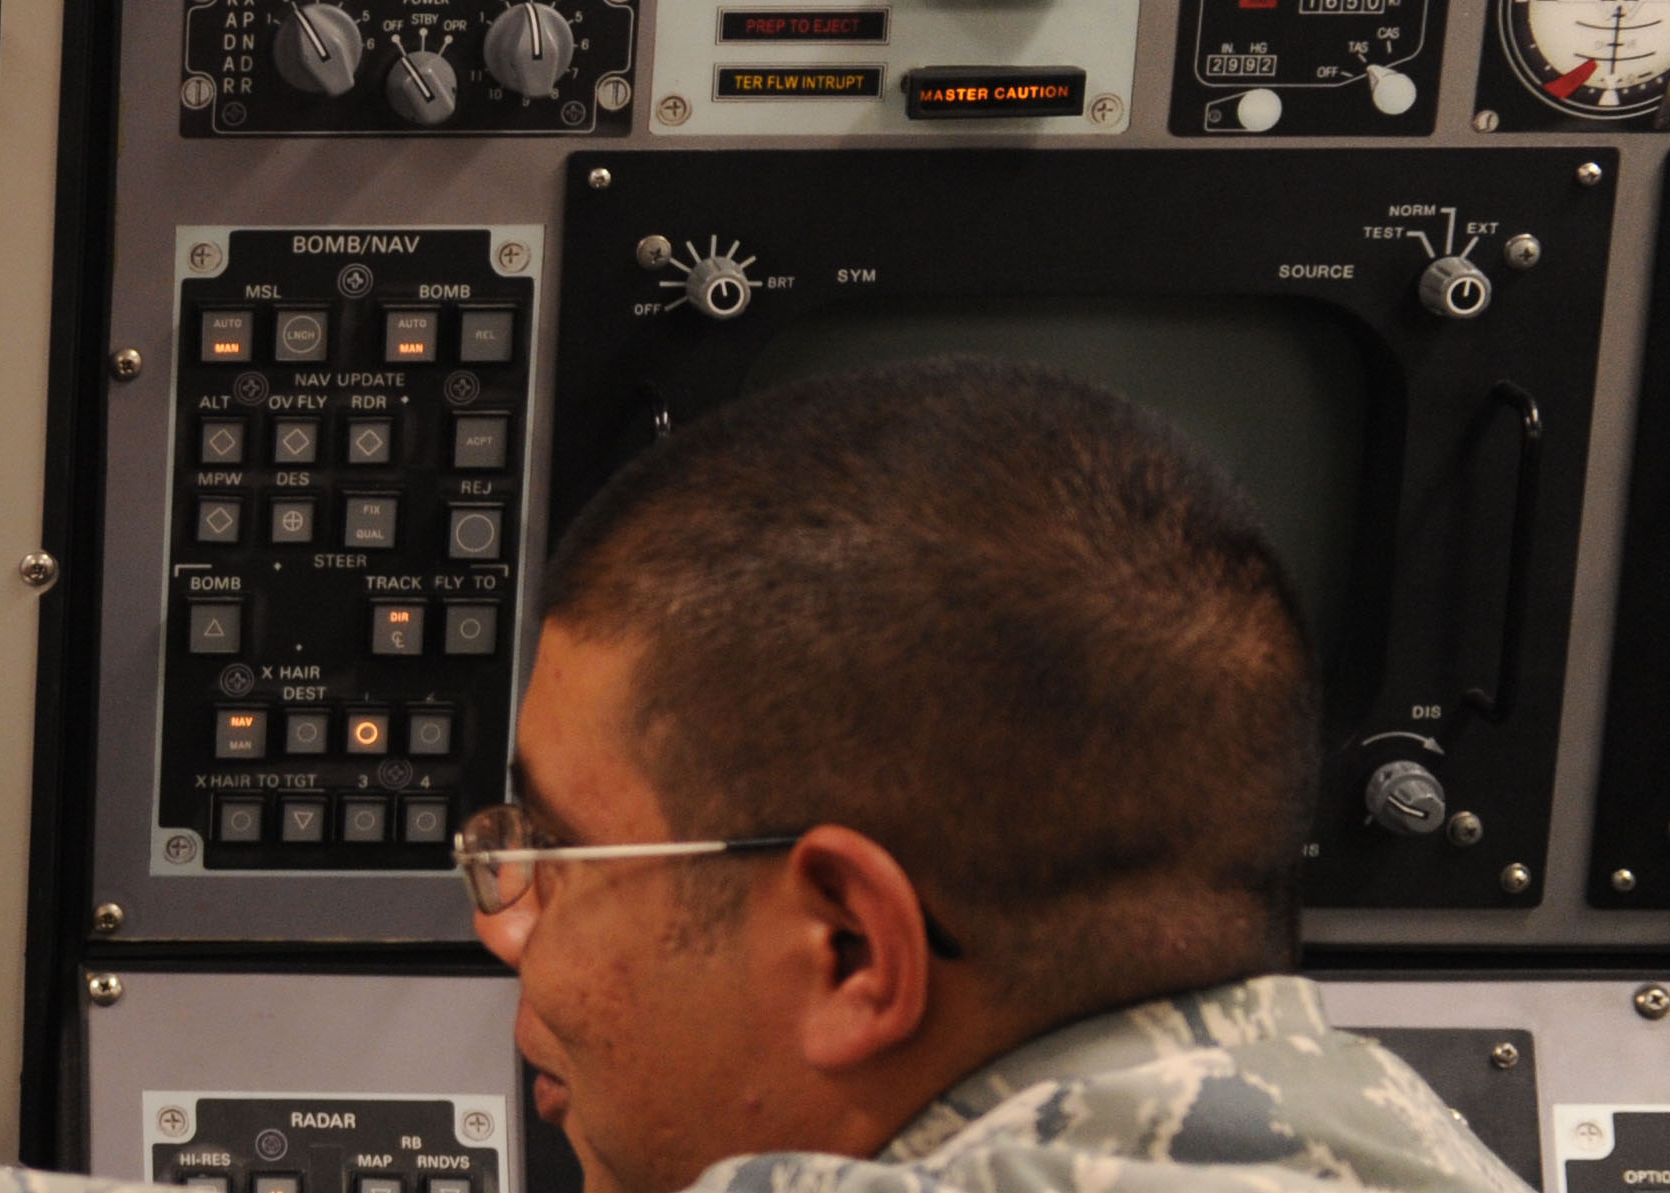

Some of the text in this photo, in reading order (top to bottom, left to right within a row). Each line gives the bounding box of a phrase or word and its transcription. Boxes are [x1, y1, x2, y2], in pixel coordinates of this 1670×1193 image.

[383, 20, 403, 32] OFF
[412, 14, 438, 25] STBY
[444, 20, 466, 32] OPR
[746, 18, 859, 34] PREP TO EJECT
[1378, 27, 1399, 40] CAS
[1250, 42, 1268, 54] HG
[1348, 41, 1368, 54] TAS
[1212, 58, 1272, 73] 2992
[1317, 67, 1338, 78] OFF
[735, 74, 864, 90] TER FLW INTRUPT
[919, 86, 1069, 102] MASTER CAUTION
[1389, 205, 1436, 217] NORM
[1364, 226, 1403, 239] TEST
[1467, 222, 1498, 234] EXT
[293, 236, 419, 254] BOMB/NAV
[837, 269, 876, 283] SYM
[1279, 265, 1354, 279] SOURCE
[768, 277, 794, 289] BRT
[246, 285, 281, 298] MSL
[419, 285, 470, 298] BOMB
[634, 304, 660, 316] OFF
[213, 319, 241, 328] AUTO
[398, 319, 426, 328] AUTO
[215, 344, 239, 353] MAN
[400, 344, 423, 353] MAN
[295, 373, 405, 387] NAV UPDATE
[200, 396, 229, 408] ALT
[298, 396, 327, 409] FLY
[352, 396, 386, 409] RDR
[198, 473, 242, 486] MPW
[277, 473, 309, 486] DES
[461, 481, 492, 494] REJ
[364, 505, 380, 515] FIX
[314, 555, 367, 568] STEER
[191, 577, 241, 590] BOMB
[367, 577, 496, 590] TRACK FLY TO
[390, 612, 409, 622] DIR
[262, 667, 320, 679] X HAIR
[284, 687, 326, 700] DEST
[1412, 705, 1441, 719] DIS
[231, 717, 253, 727] NAV
[196, 775, 316, 788] X HAIR TO TGT
[359, 775, 368, 788] 3
[420, 775, 430, 788] 4
[291, 1113, 356, 1129] RADAR
[401, 1136, 421, 1149] RB
[180, 1153, 230, 1167] HI-RES
[358, 1154, 392, 1168] MAP
[417, 1155, 469, 1169] RNDVS
